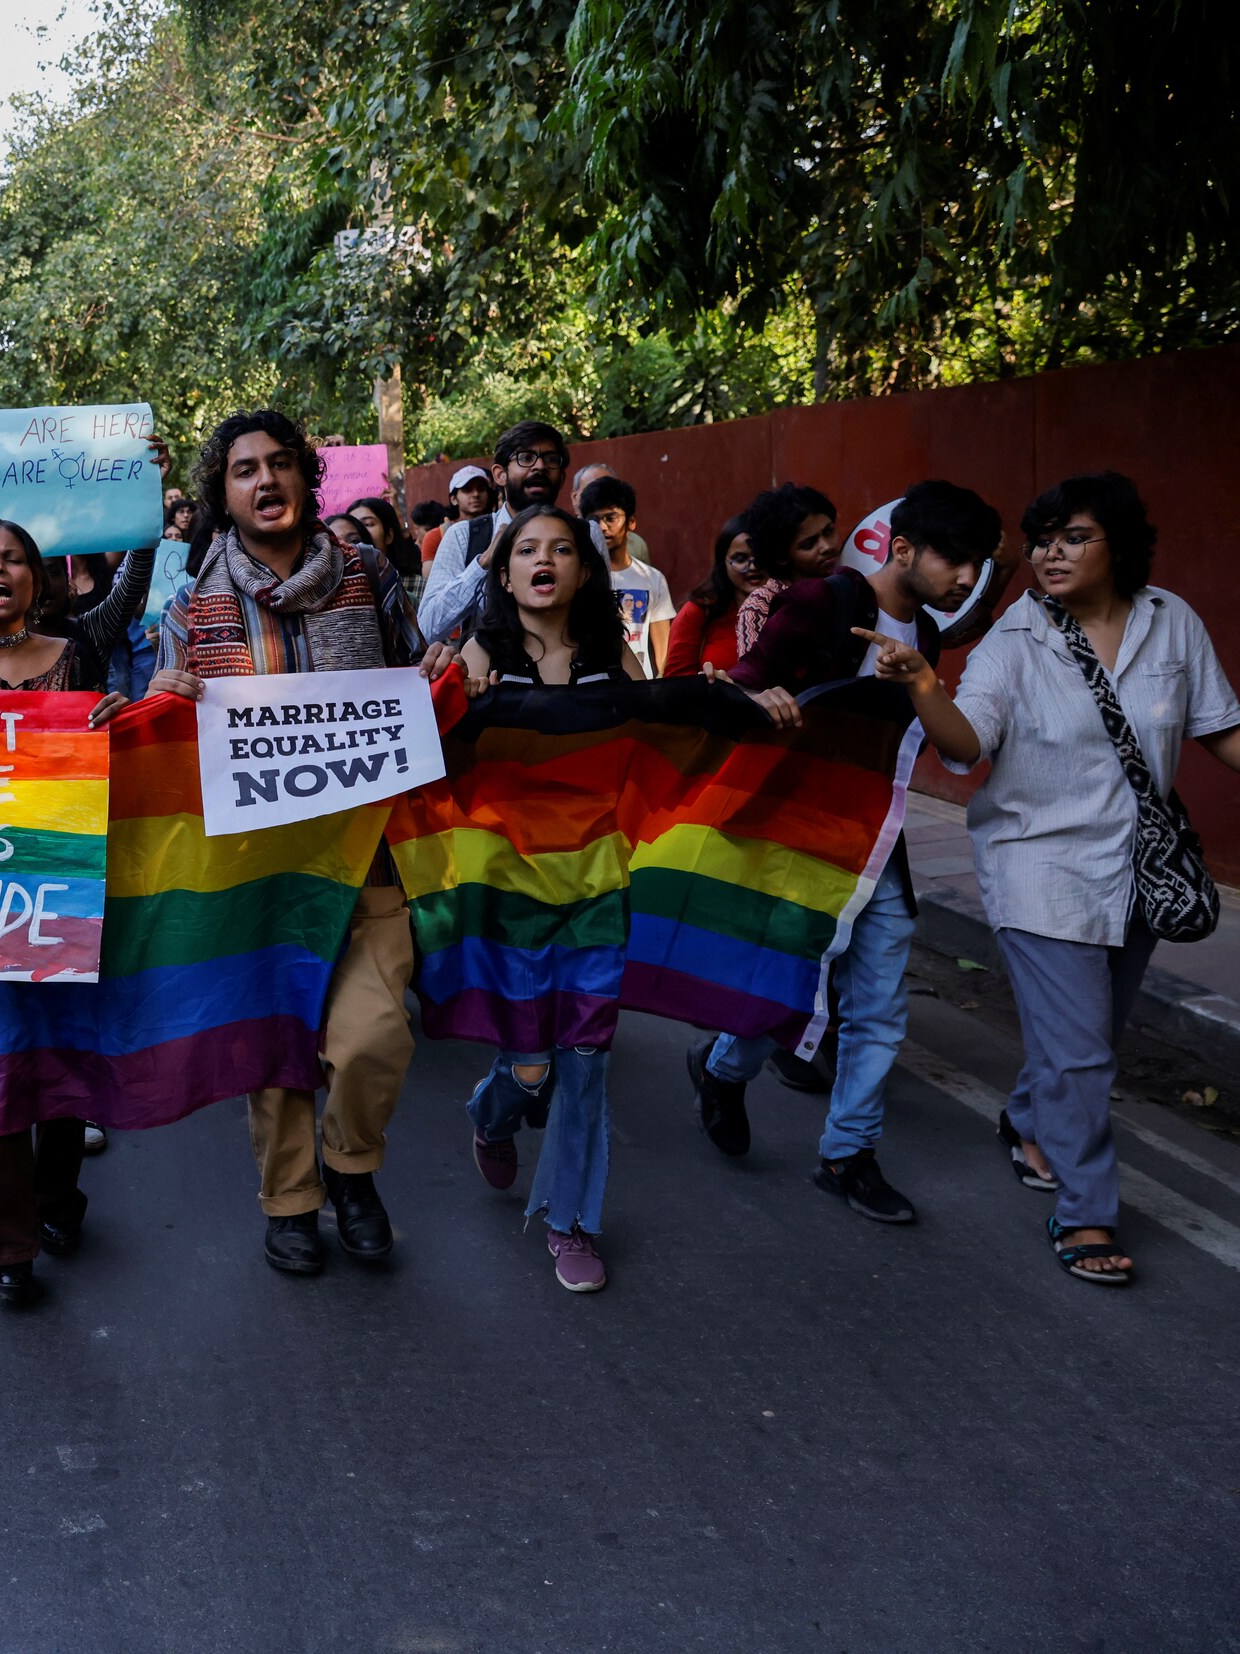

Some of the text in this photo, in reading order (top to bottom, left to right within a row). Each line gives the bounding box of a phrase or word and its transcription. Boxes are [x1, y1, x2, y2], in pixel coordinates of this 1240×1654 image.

[20, 416, 75, 446] ARE
[93, 412, 151, 439] HERE
[2, 458, 47, 488] ARE
[52, 450, 143, 489] QUEER
[227, 699, 402, 728] MARRIAGE
[230, 724, 404, 759] EQUALITY
[232, 747, 410, 807] NOW!
